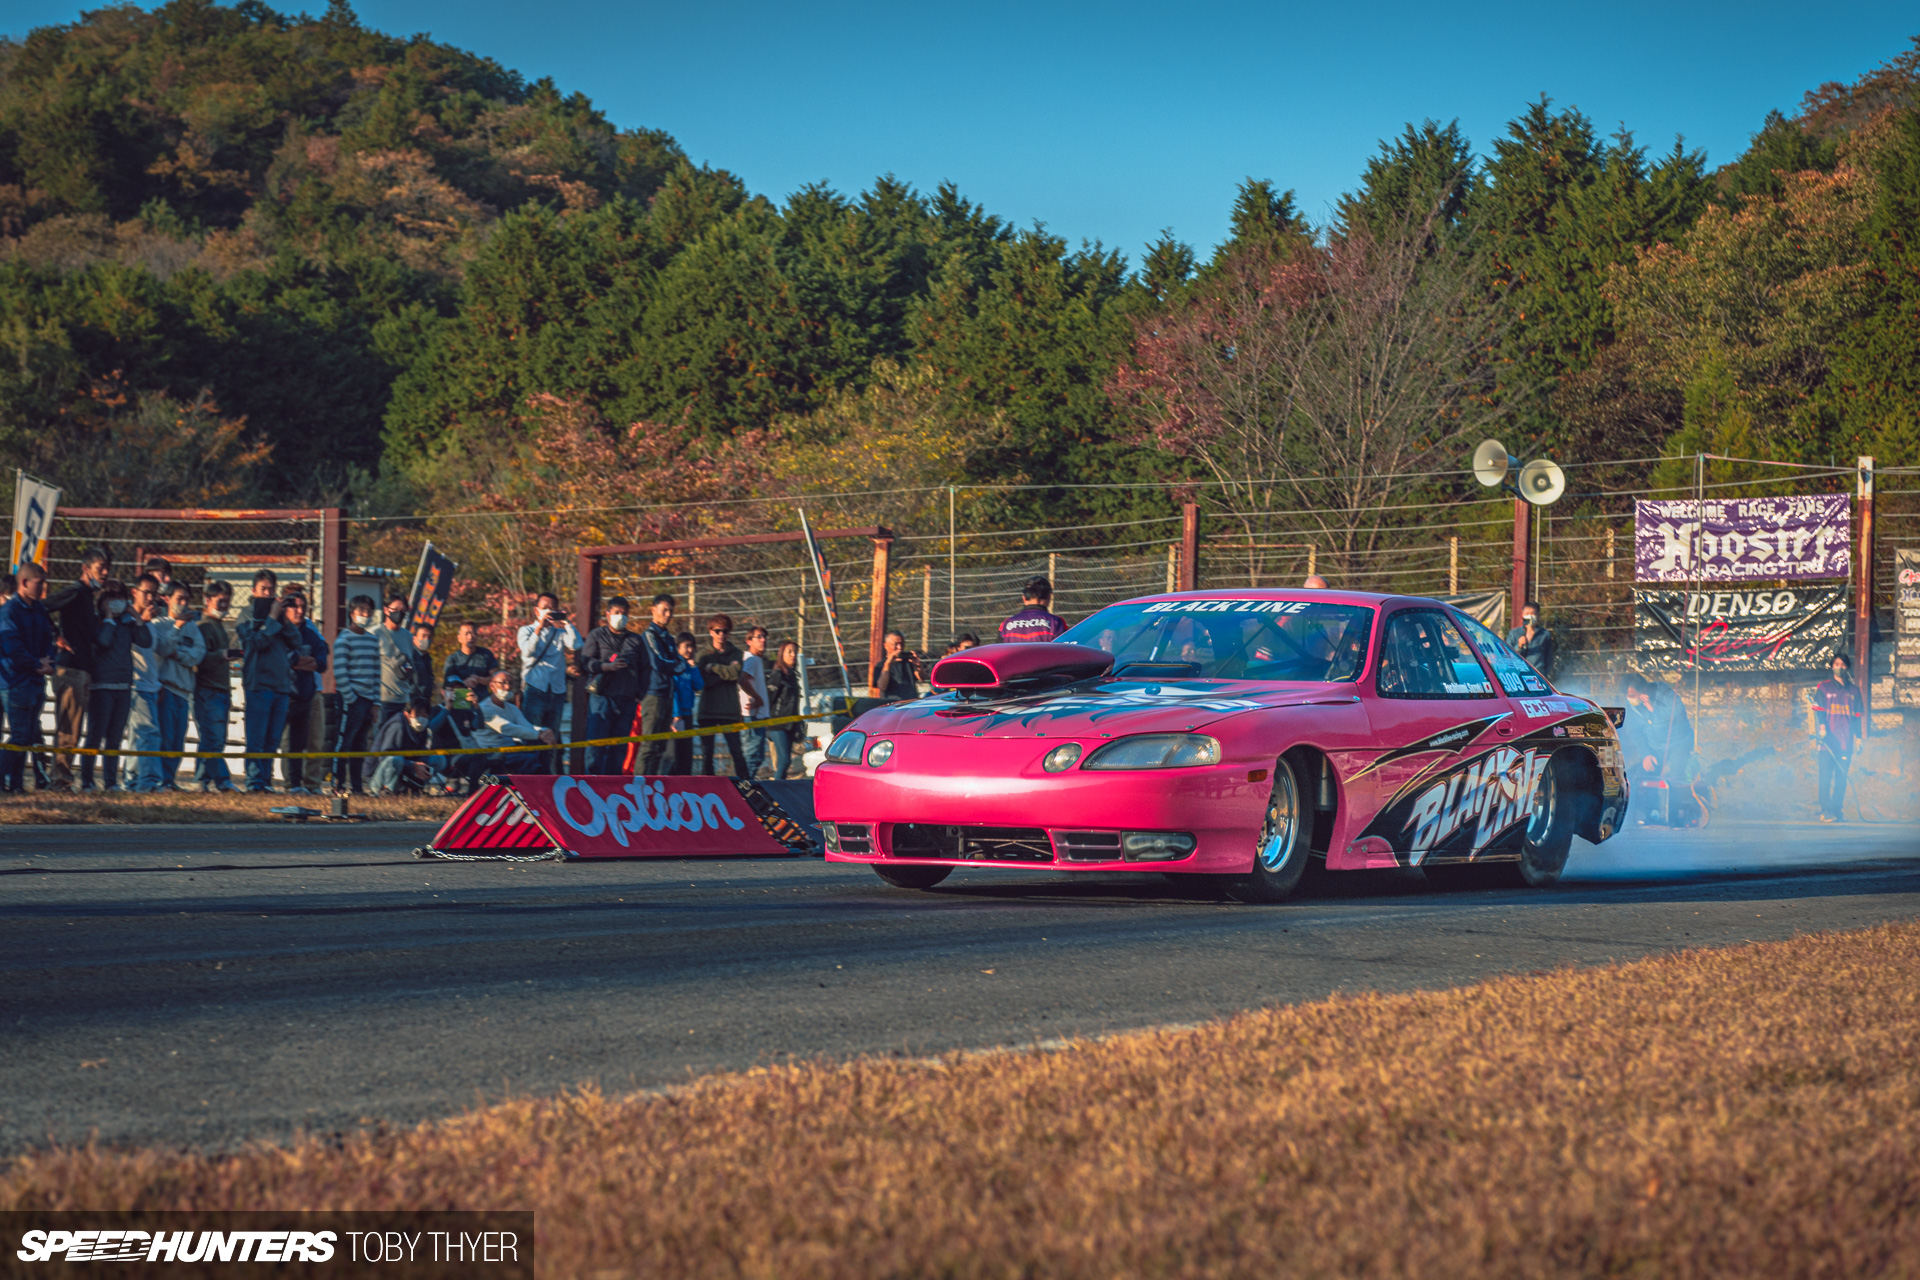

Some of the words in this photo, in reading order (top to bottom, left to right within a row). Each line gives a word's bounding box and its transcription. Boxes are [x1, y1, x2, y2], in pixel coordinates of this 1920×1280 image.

[1660, 504, 1726, 519] WELCOME
[1738, 502, 1776, 518] RACE
[1788, 500, 1826, 515] FANS
[1649, 516, 1837, 573] Hoosier
[1705, 562, 1779, 577] RACING
[1784, 560, 1825, 575] TIRE
[1142, 601, 1231, 614] BLACK
[1238, 601, 1311, 615] LINE
[1686, 590, 1796, 617] DENSO
[1005, 618, 1051, 631] OFFICIAL
[1685, 617, 1792, 670] Racing
[1499, 672, 1525, 692] 909
[1519, 699, 1550, 719] GCG
[1565, 726, 1585, 735] TRUST
[552, 775, 745, 848] Option
[1401, 744, 1524, 867] BLACK
[1469, 746, 1552, 862] LINE
